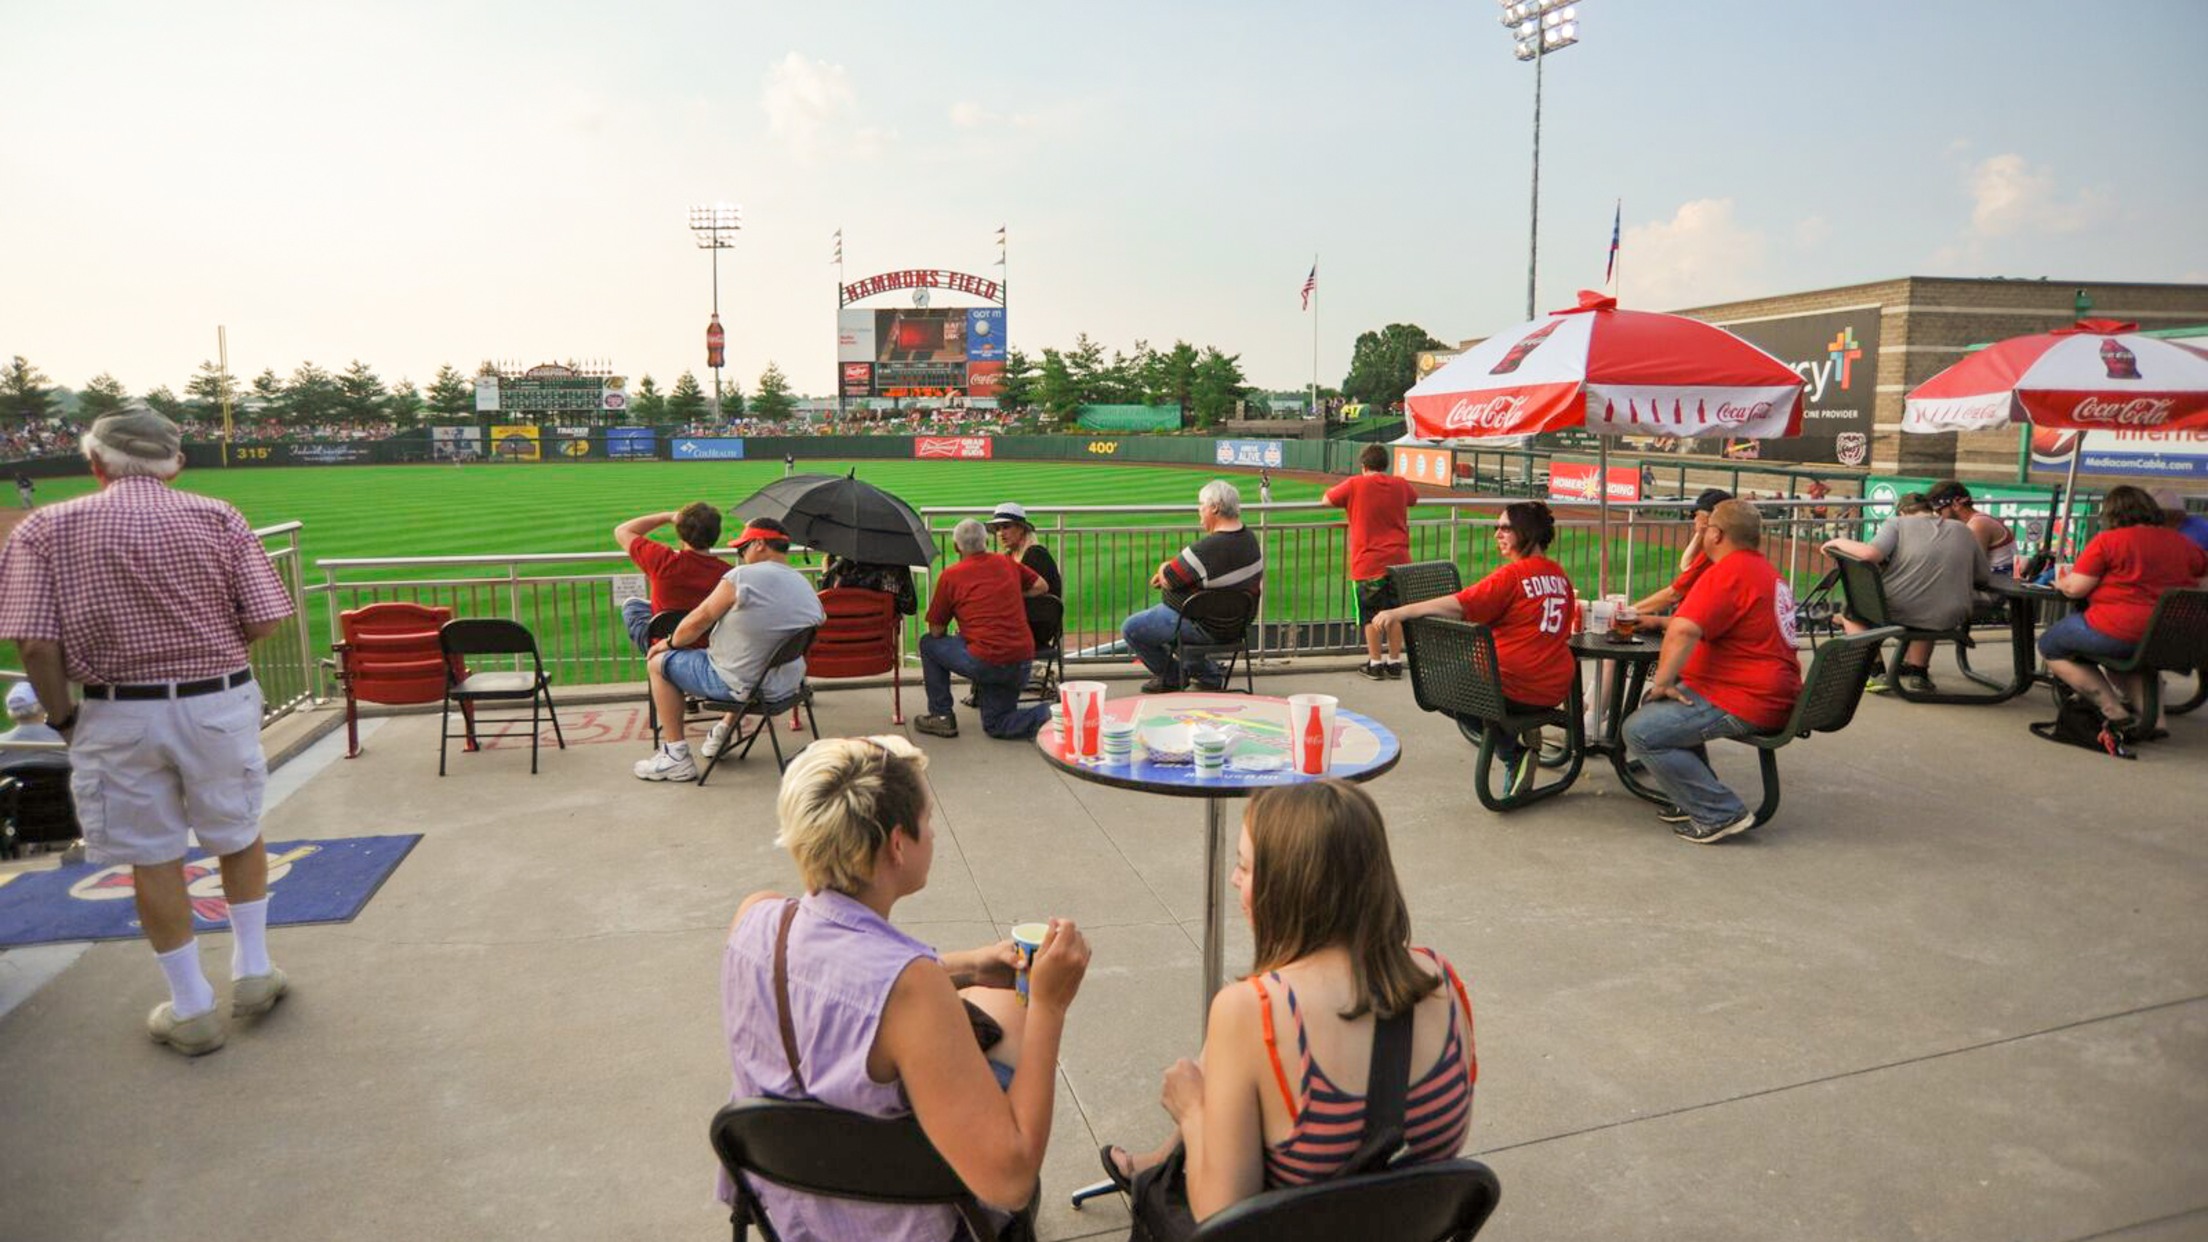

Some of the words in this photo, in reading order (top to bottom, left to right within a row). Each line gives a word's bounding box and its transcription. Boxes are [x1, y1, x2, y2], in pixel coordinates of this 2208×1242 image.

[845, 269, 940, 300] HAMMONS
[950, 271, 998, 300] FIELD
[1446, 395, 1529, 429] Coca-Cola
[1821, 409, 1858, 419] PROVIDER
[2072, 396, 2177, 426] Coca-Cola
[1088, 441, 1118, 454] 400'
[2084, 456, 2193, 471] MediacomCable.com
[1593, 480, 1635, 497] LNDING
[1539, 597, 1567, 634] 15
